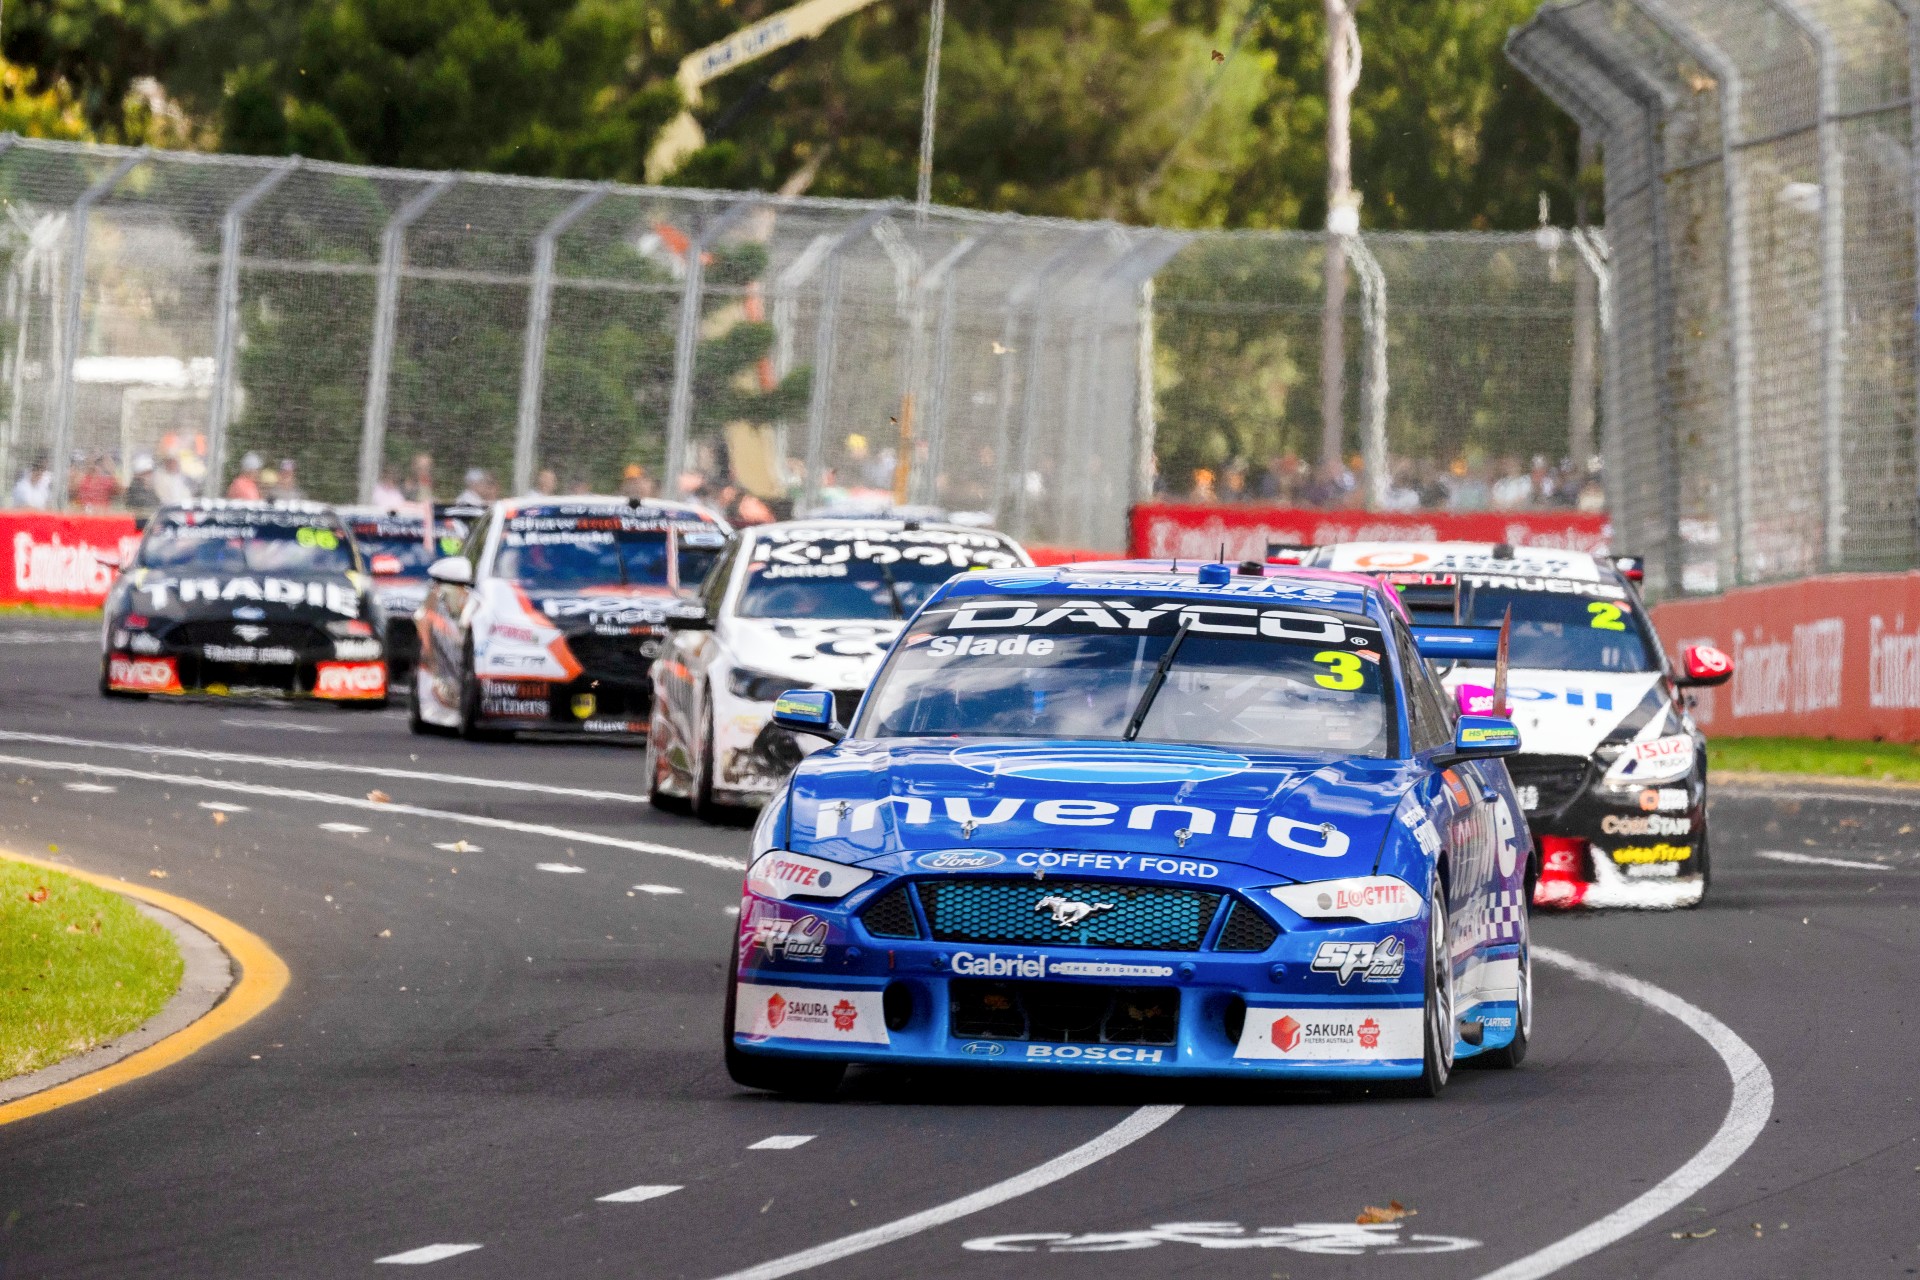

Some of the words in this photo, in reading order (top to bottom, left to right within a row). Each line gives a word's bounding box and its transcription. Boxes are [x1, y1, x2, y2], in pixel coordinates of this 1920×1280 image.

[762, 562, 849, 579] Jones
[140, 577, 361, 619] TRADIE
[1463, 574, 1627, 599] TRUCKS
[947, 600, 1346, 643] DAYCO
[1587, 602, 1627, 631] 2
[926, 634, 1055, 657] Slade
[1313, 650, 1364, 691] 3
[816, 795, 1350, 858] invenio
[933, 852, 988, 867] Ford
[1017, 852, 1133, 871] COFFEY
[1140, 857, 1219, 879] FORD
[1336, 885, 1406, 910] LOCTITE
[951, 951, 1047, 979] Gabriel
[1066, 965, 1088, 973] THE
[1096, 966, 1156, 975] ORIGINAL
[788, 1001, 829, 1017] SAKURA
[1305, 1023, 1354, 1037] SAKURA
[1026, 1045, 1163, 1063] BOSCH
